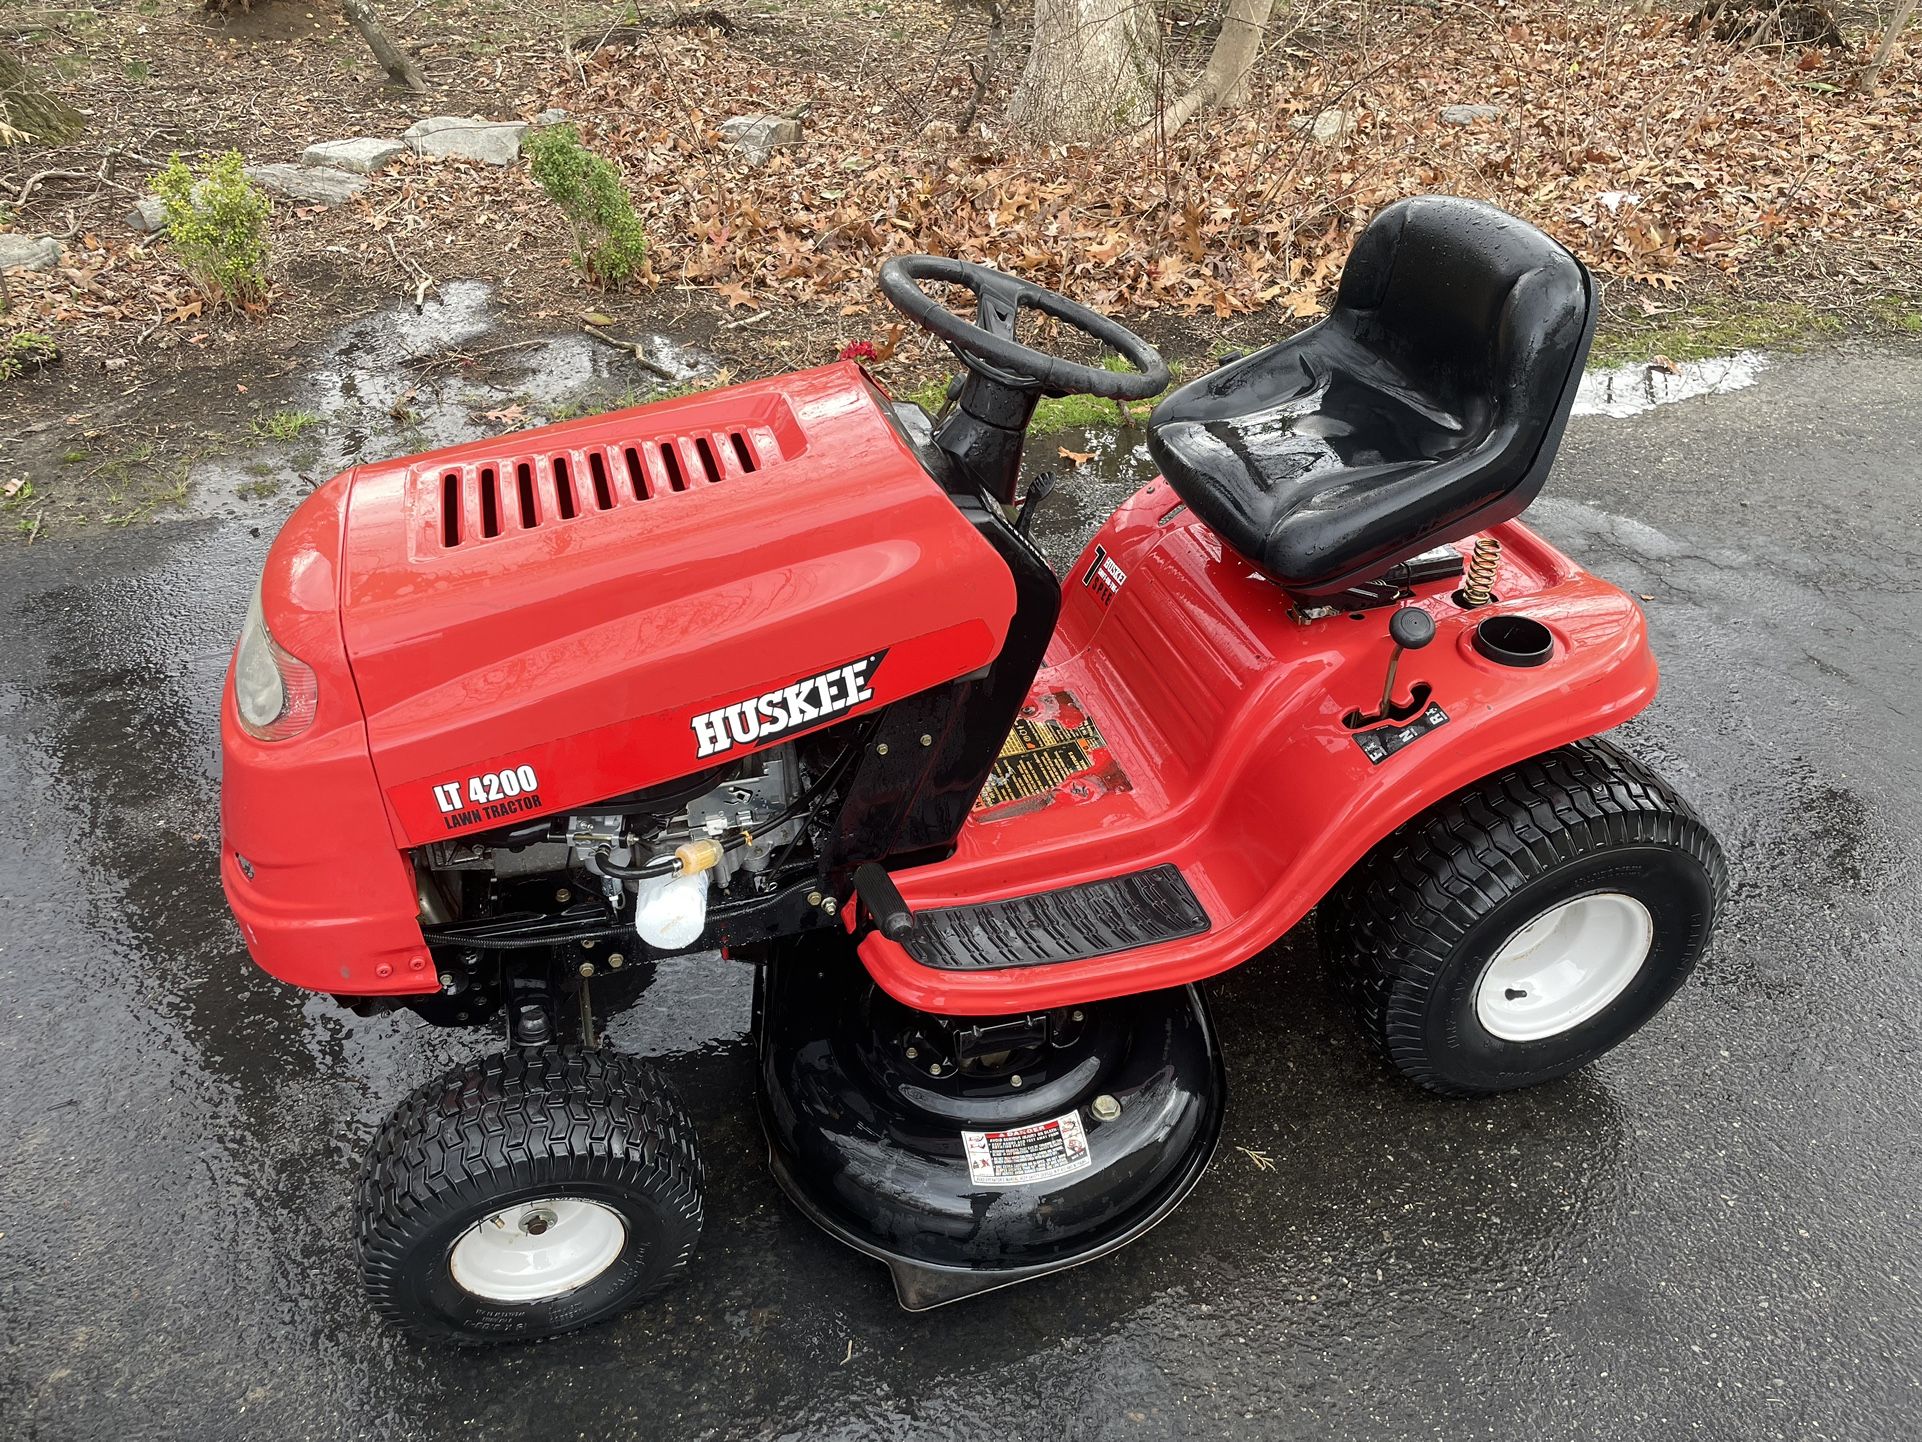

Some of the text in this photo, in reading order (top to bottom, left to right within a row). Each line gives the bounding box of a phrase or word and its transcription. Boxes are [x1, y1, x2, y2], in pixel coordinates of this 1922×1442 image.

[691, 660, 874, 758] HUSKEE
[1430, 714, 1443, 725] R
[1399, 730, 1414, 742] N
[1370, 751, 1383, 761] F
[433, 765, 538, 813] LT 4200
[444, 795, 542, 829] LAWN TRACTOR
[1007, 1126, 1046, 1136] DANGER
